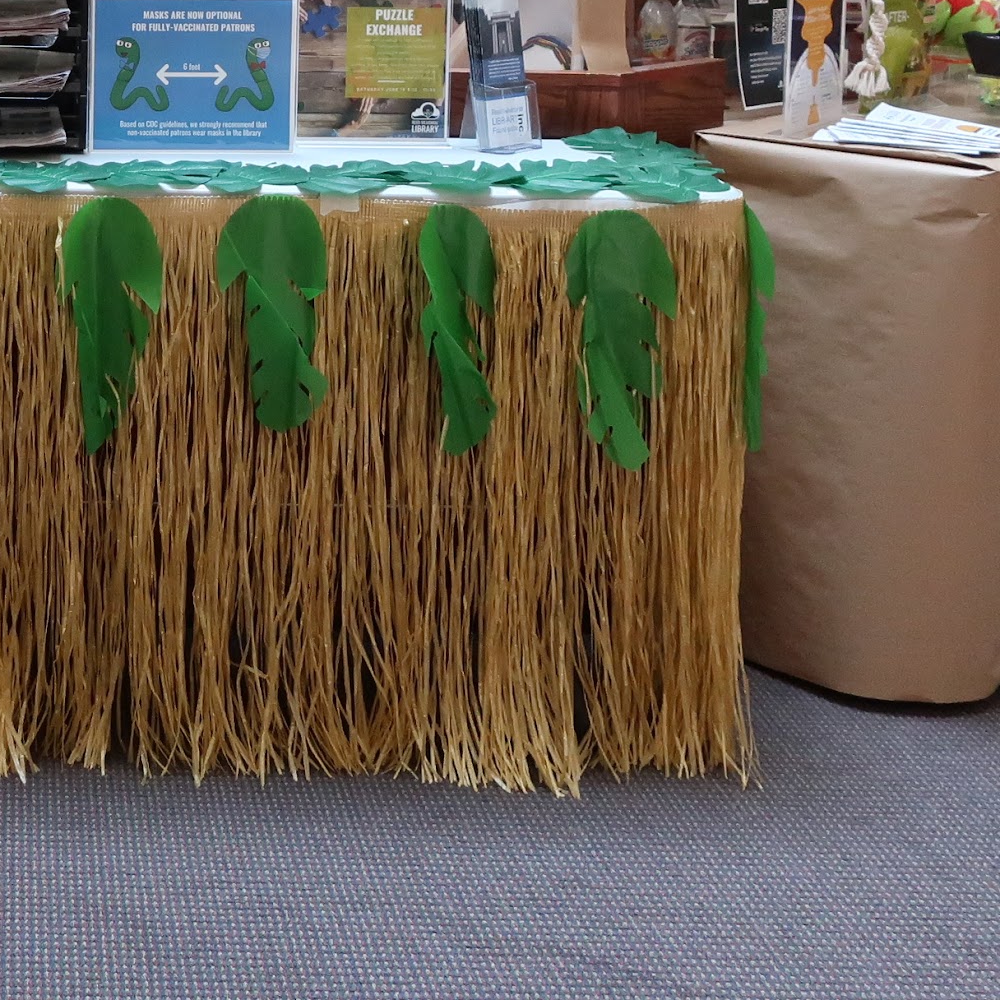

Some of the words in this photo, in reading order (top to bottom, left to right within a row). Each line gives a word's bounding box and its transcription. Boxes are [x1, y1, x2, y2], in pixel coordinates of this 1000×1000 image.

[143, 10, 168, 20] MASKS
[170, 10, 186, 20] ARE
[187, 11, 204, 20] NOW
[206, 11, 242, 20] OPTIONAL
[375, 9, 414, 21] PUZZLE
[132, 23, 146, 32] FOR
[148, 23, 219, 32] FULLY-VACCINATED
[221, 24, 255, 32] PATRONS
[366, 24, 422, 36] EXCHANGE
[182, 62, 188, 71] 6
[199, 121, 221, 129] strongly
[411, 125, 439, 133] LIBRARY
